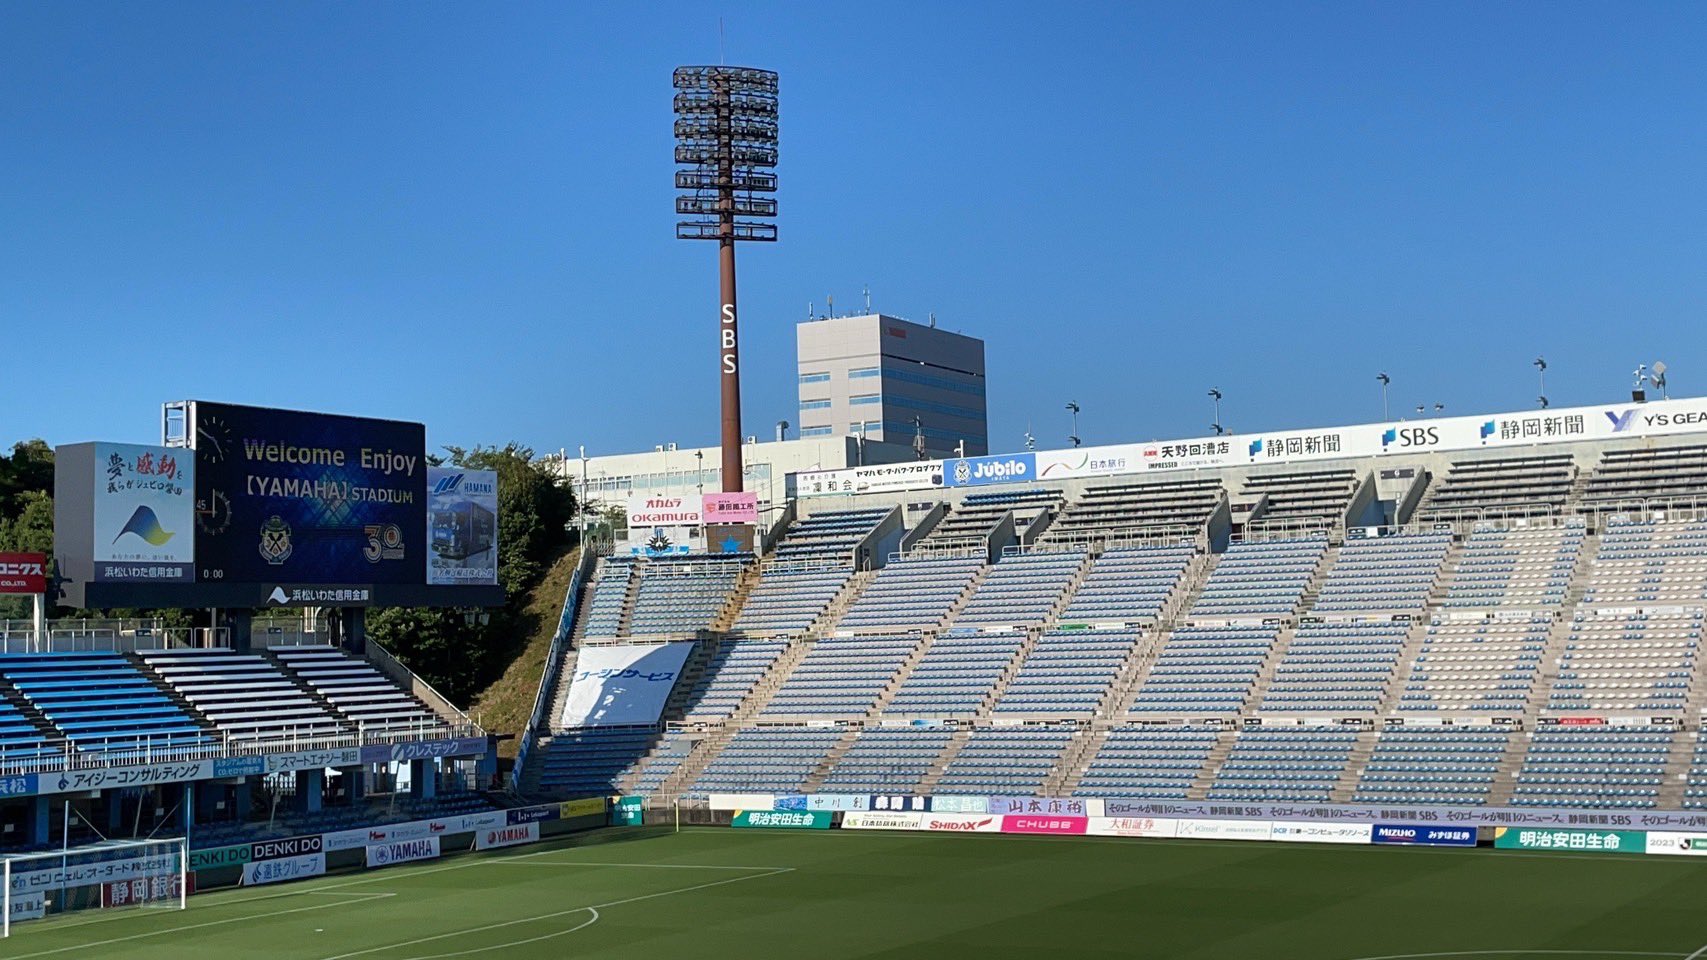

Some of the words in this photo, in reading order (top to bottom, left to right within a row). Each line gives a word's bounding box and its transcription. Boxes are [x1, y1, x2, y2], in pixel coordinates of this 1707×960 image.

[721, 303, 737, 374] SBS
[1500, 414, 1584, 440] 静岡新聞
[1644, 414, 1669, 426] Y'S
[1400, 427, 1439, 447] SBS
[1267, 434, 1341, 457] 静岡新聞
[243, 438, 345, 467] Welcome
[360, 448, 417, 475] Enjoy
[1090, 458, 1126, 469] 日本旅行
[351, 487, 413, 503] STADIUM
[645, 498, 681, 509] オカムラ
[104, 566, 183, 578] 浜松いわた信用金庫
[203, 569, 224, 579] 0:00
[292, 588, 369, 602] 浜松いわた信用金庫
[406, 741, 459, 759] クレステック
[73, 764, 200, 788] アイジーコンサルティング
[1245, 806, 1262, 817] SBS
[1419, 811, 1438, 821] SBS
[749, 813, 815, 826] 明治安田生命
[929, 820, 977, 830] SHIDAX
[1017, 820, 1072, 829] CHUBB
[1110, 818, 1155, 830] 大和証券
[1611, 815, 1632, 825] SBS
[497, 828, 530, 843] YAMAHA
[1379, 829, 1416, 838] MIZUHO
[1428, 831, 1470, 840] みずほ証券
[1519, 832, 1621, 850] 明治安田生命
[227, 849, 250, 862] DO
[253, 843, 297, 859] DENKI
[300, 838, 321, 851] DO
[389, 840, 432, 860] YAMAHA
[263, 857, 319, 881] 遠鉄グループ
[111, 875, 183, 905] 静岡銀行
